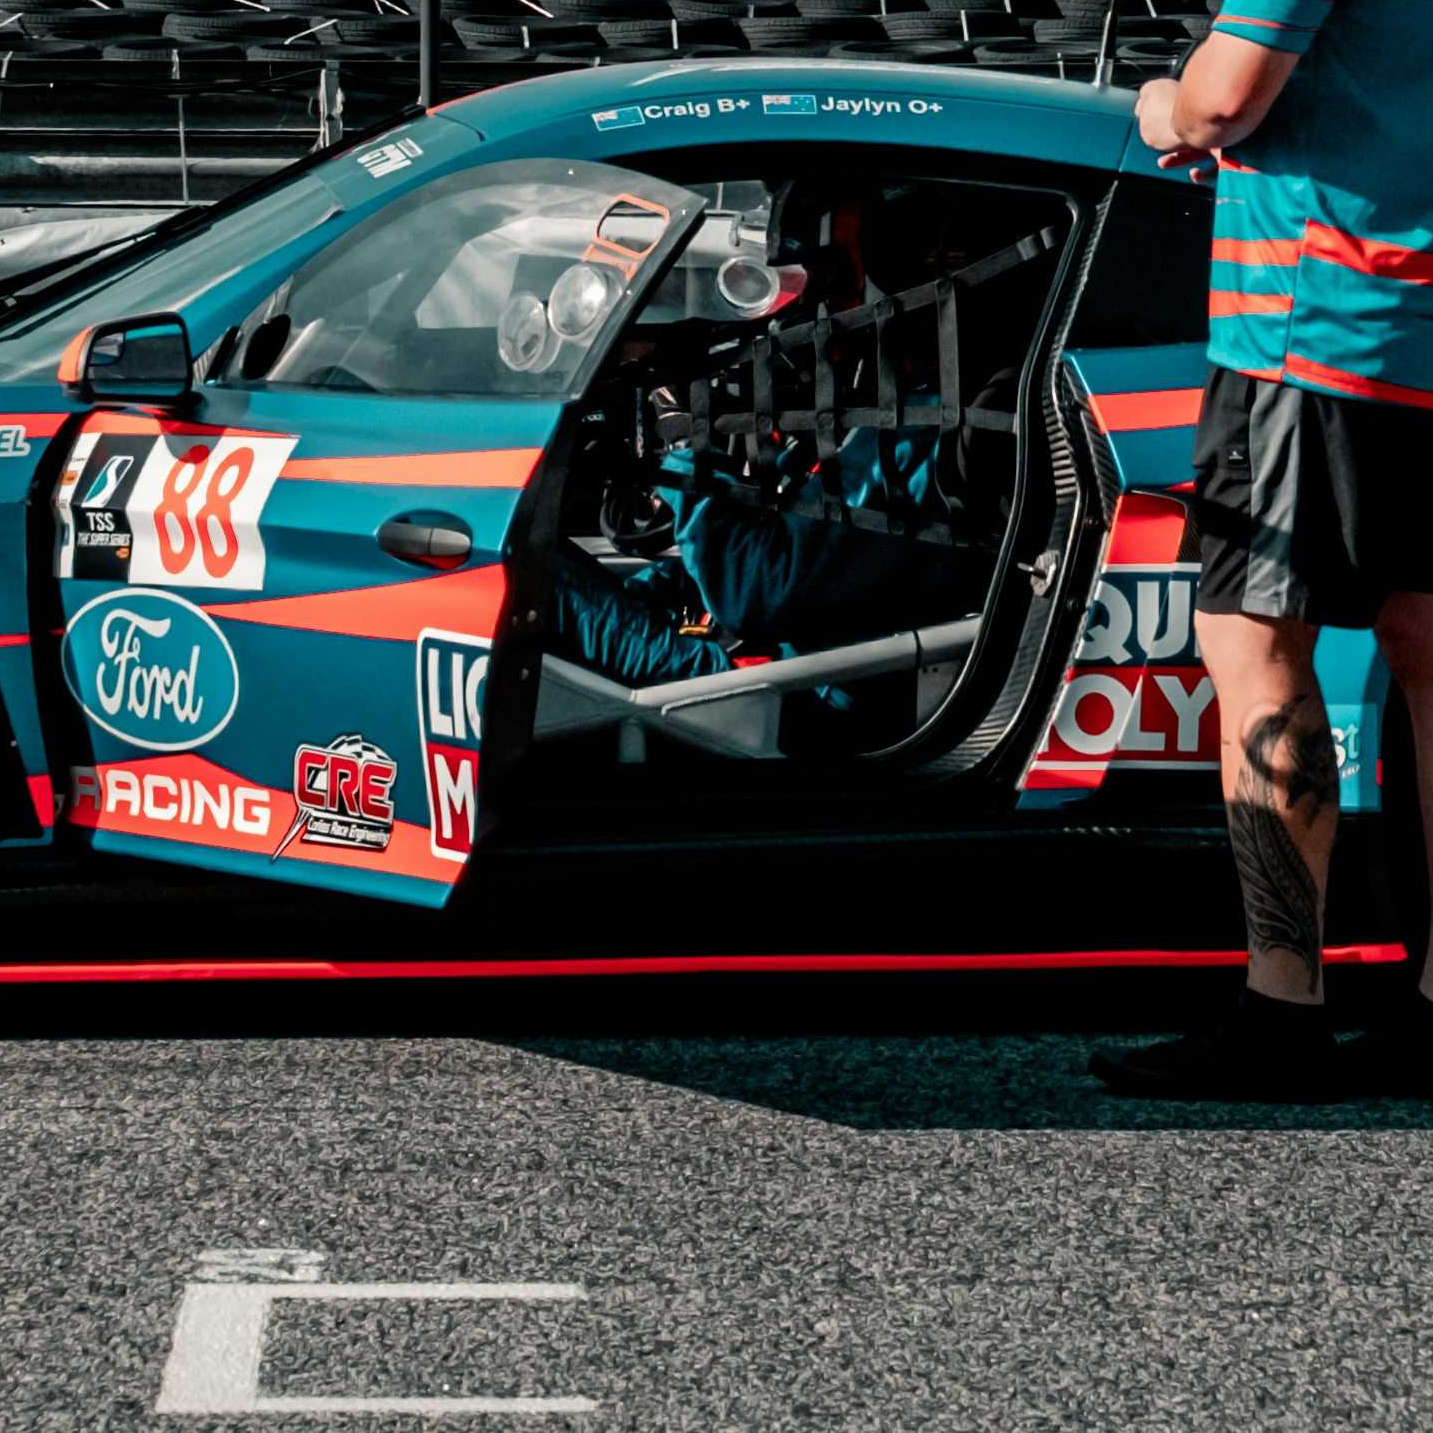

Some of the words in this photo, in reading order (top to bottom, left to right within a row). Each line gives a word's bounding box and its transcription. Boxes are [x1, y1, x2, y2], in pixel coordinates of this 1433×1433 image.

[644, 102, 711, 118] Craig
[718, 98, 750, 112] B+
[821, 96, 901, 116] Jaylyn
[908, 99, 944, 114] O+
[86, 511, 116, 532] TSS
[153, 444, 255, 579] 88
[96, 607, 204, 725] Ford
[72, 765, 272, 835] RACING
[297, 750, 395, 821] CRE
